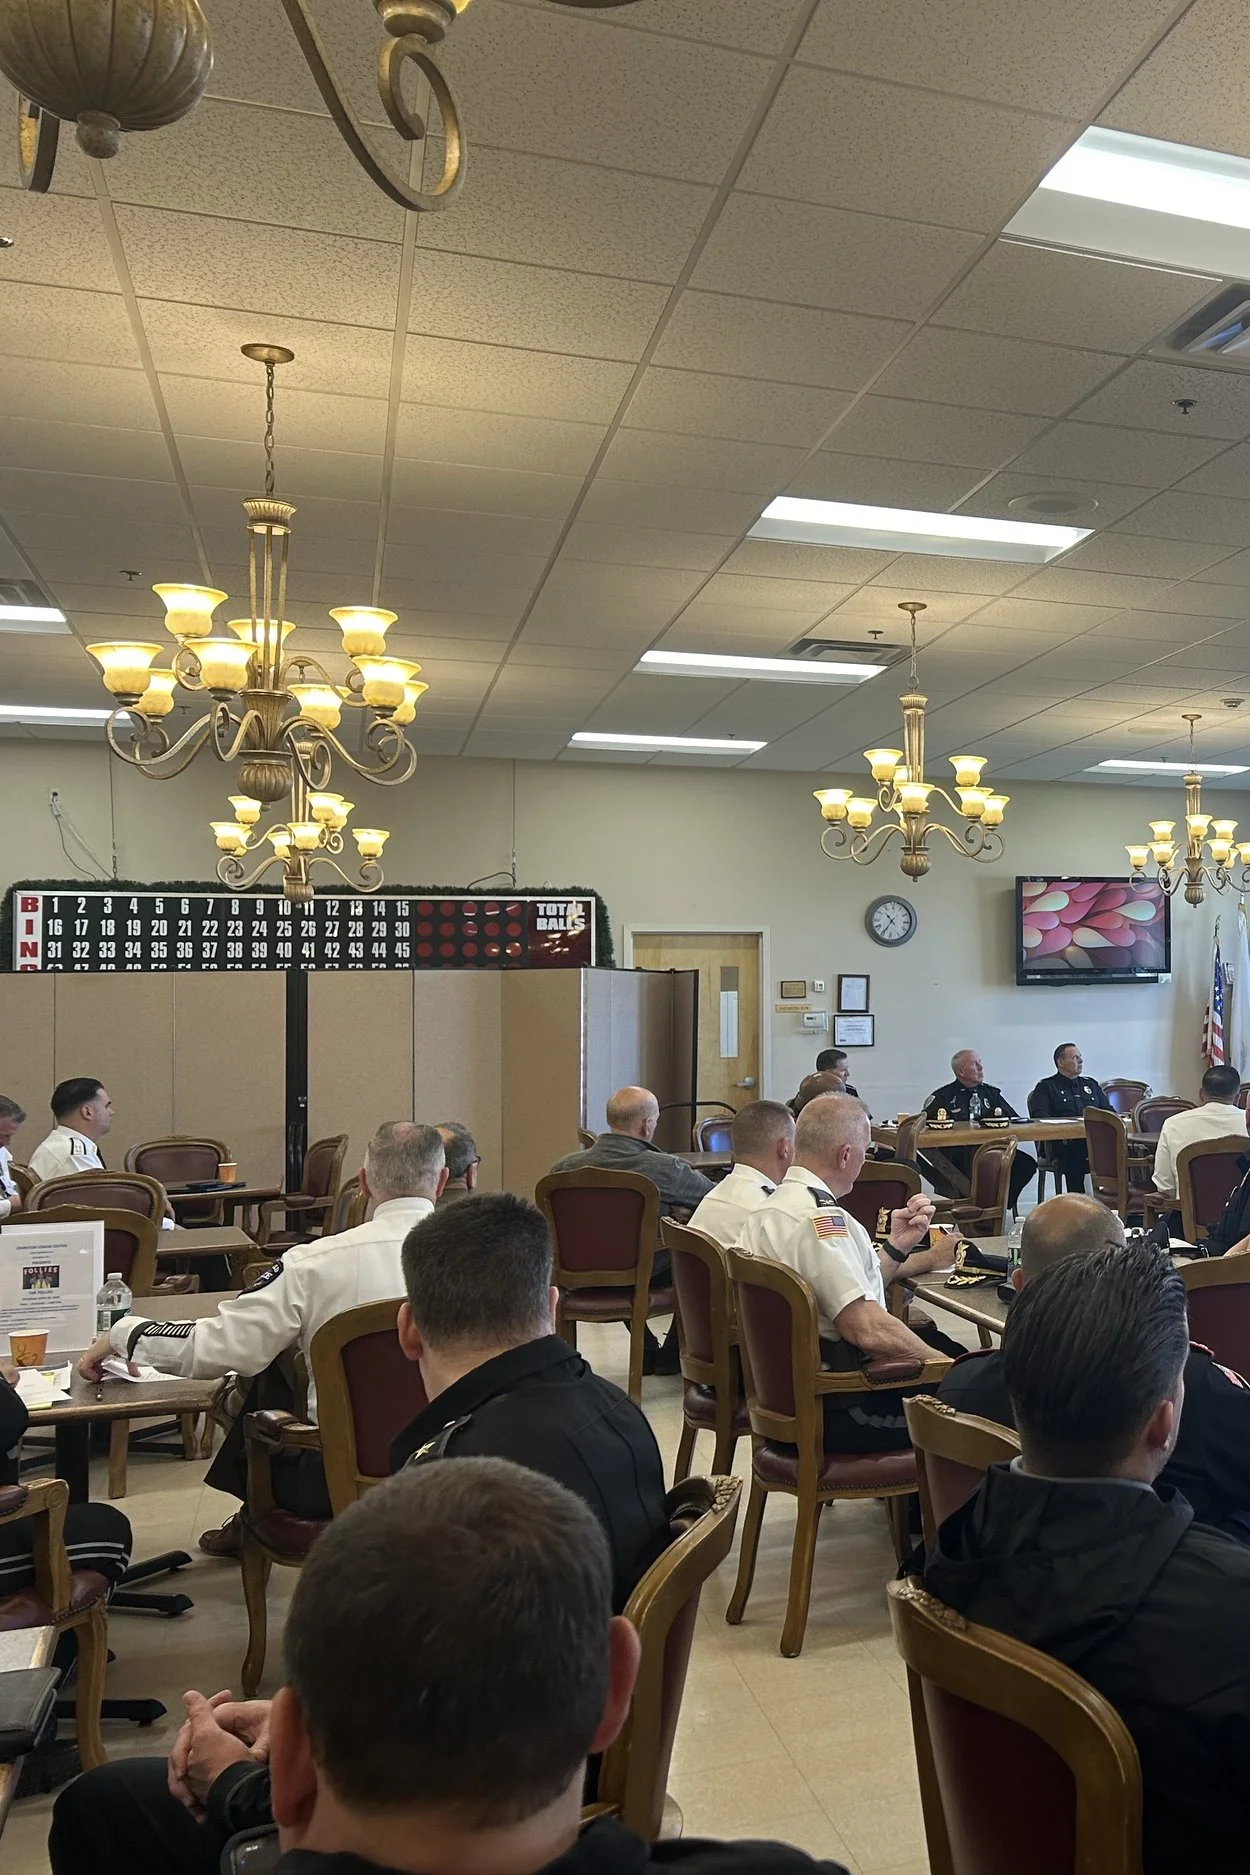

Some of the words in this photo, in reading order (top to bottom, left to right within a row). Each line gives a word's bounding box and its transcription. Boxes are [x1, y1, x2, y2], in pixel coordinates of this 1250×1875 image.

[21, 897, 38, 913] B
[52, 897, 59, 914] 1
[78, 897, 86, 914] 2
[104, 897, 112, 914] 3
[129, 898, 138, 914] 4
[155, 898, 164, 915] 5
[180, 898, 189, 915] 6
[207, 899, 214, 915] 7
[231, 899, 240, 916] 8
[256, 899, 265, 916] 9
[278, 899, 291, 916] 10
[304, 900, 314, 916] 11
[326, 900, 340, 916] 12
[350, 900, 363, 916] 13
[372, 900, 386, 916] 14
[396, 900, 410, 917] 15
[536, 903, 586, 916] TOTAL
[25, 920, 33, 935] I
[48, 919, 62, 936] 16
[75, 919, 89, 936] 17
[100, 919, 115, 936] 18
[126, 919, 142, 936] 19
[151, 919, 168, 937] 20
[178, 920, 192, 937] 21
[202, 920, 218, 937] 22
[227, 921, 243, 937] 23
[252, 921, 268, 937] 24
[276, 920, 292, 937] 25
[300, 920, 317, 937] 26
[325, 921, 339, 938] 27
[348, 921, 364, 937] 28
[371, 921, 387, 937] 29
[395, 921, 410, 937] 30
[536, 917, 586, 931] BALLS
[20, 942, 38, 958] N
[48, 941, 61, 958] 31
[72, 941, 89, 959] 32
[99, 941, 116, 959] 33
[125, 941, 141, 959] 34
[151, 941, 167, 959] 35
[176, 941, 193, 959] 36
[202, 941, 218, 959] 37
[227, 942, 243, 959] 38
[251, 941, 267, 959] 39
[276, 941, 292, 958] 40
[301, 941, 315, 959] 41
[325, 941, 340, 958] 42
[348, 942, 364, 958] 43
[371, 942, 387, 958] 44
[394, 942, 410, 958] 45
[24, 1266, 58, 1275] FOLLIES
